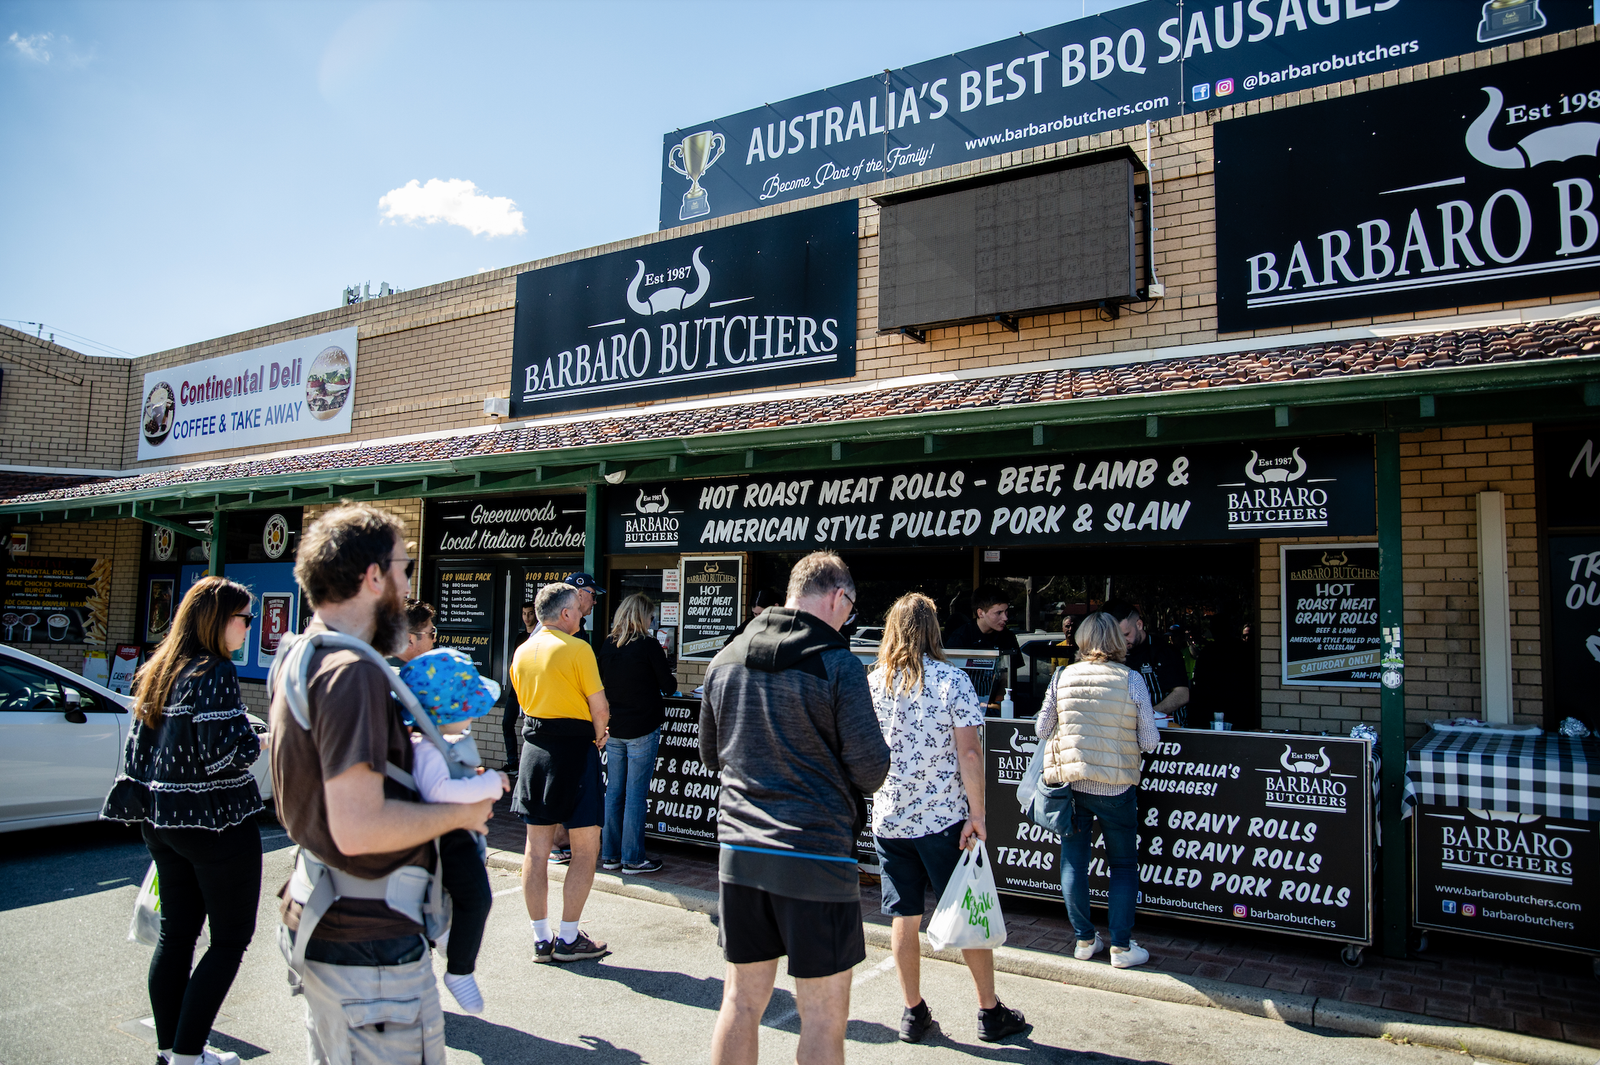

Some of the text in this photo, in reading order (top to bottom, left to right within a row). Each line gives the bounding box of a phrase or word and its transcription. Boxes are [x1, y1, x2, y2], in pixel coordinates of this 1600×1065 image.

[1242, 39, 1420, 91] @barbarobutchers
[746, 0, 1401, 165] AUSTRALIA'S BEST BBQ SAUSAG
[1506, 89, 1600, 126] Est 198
[965, 95, 1169, 151] www.barbarobutchers.com
[759, 173, 811, 200] Become
[813, 162, 852, 190] Part
[852, 159, 866, 180] of
[884, 143, 936, 174] Family!
[1245, 188, 1532, 296] BARBARO
[644, 266, 691, 287] Est 1987
[523, 315, 839, 394] BARBARO BUTCHERS
[180, 357, 303, 407] Continental Deli
[173, 400, 303, 440] COFFEE & TAKE AWAY
[1257, 456, 1293, 467] Est 1987
[699, 456, 1190, 510] HOT ROAST MEAT ROLLS BEEF, LAMB &
[1227, 486, 1328, 511] BARBARO
[470, 500, 557, 525] Greenwoods
[699, 499, 1191, 545] AMERICAN STYLE PULLED PORK & SLAW
[1227, 507, 1328, 523] BUTCHERS
[625, 516, 679, 532] BARBARO
[440, 525, 586, 550] Local Italian Butcher
[625, 532, 679, 542] BUTCHERS
[17, 559, 65, 569] SPECIAL
[1290, 566, 1380, 579] BARBARO BUTCHERS
[454, 572, 474, 581] VALUE
[474, 572, 492, 581] PACK
[525, 572, 559, 581] $109 BBQ
[686, 574, 710, 582] BARBARO
[710, 574, 736, 582] BUTCHERS
[700, 586, 722, 596] HOT
[1316, 583, 1355, 596] HOT
[689, 596, 733, 606] ROAST MEAT
[1296, 598, 1376, 610] ROAST MEAT
[688, 607, 711, 616] GRAVY
[712, 607, 734, 616] ROLLS
[1295, 612, 1378, 624] GRAVY ROLLS
[452, 636, 470, 644] VALUE
[472, 636, 489, 645] PACK
[689, 641, 714, 652] SATURDAY
[1300, 654, 1374, 673] SATURDAY ONLY!
[664, 707, 691, 719] VOTED
[666, 735, 700, 748] SAUSAG
[1149, 760, 1240, 779] AUSTRALIA'S
[670, 780, 722, 800] & GRAV
[1140, 778, 1218, 796] SAUSAGES!
[1266, 776, 1347, 796] BARBARO
[1266, 792, 1347, 807] BUTCHERS
[656, 800, 702, 820] PULLED
[668, 824, 715, 838] barbarobutchers
[1144, 807, 1317, 842] & GRAVY ROLLS
[1016, 822, 1062, 844] ROAS
[1148, 836, 1163, 855] &
[1172, 839, 1245, 865] GRAVY
[1252, 847, 1322, 874] ROLLS
[1441, 826, 1573, 859] BARBARO
[1442, 848, 1573, 876] BUTCHERS
[997, 847, 1054, 870] TEXAS
[1137, 863, 1202, 888] ULLED
[1210, 872, 1272, 897] PORK
[1278, 880, 1350, 908] ROLLS
[1434, 884, 1582, 911] www.barbarobutchers.com
[1145, 894, 1336, 928] barbarobutchers barbarobutchers
[1482, 907, 1574, 930] barbarobutchers
